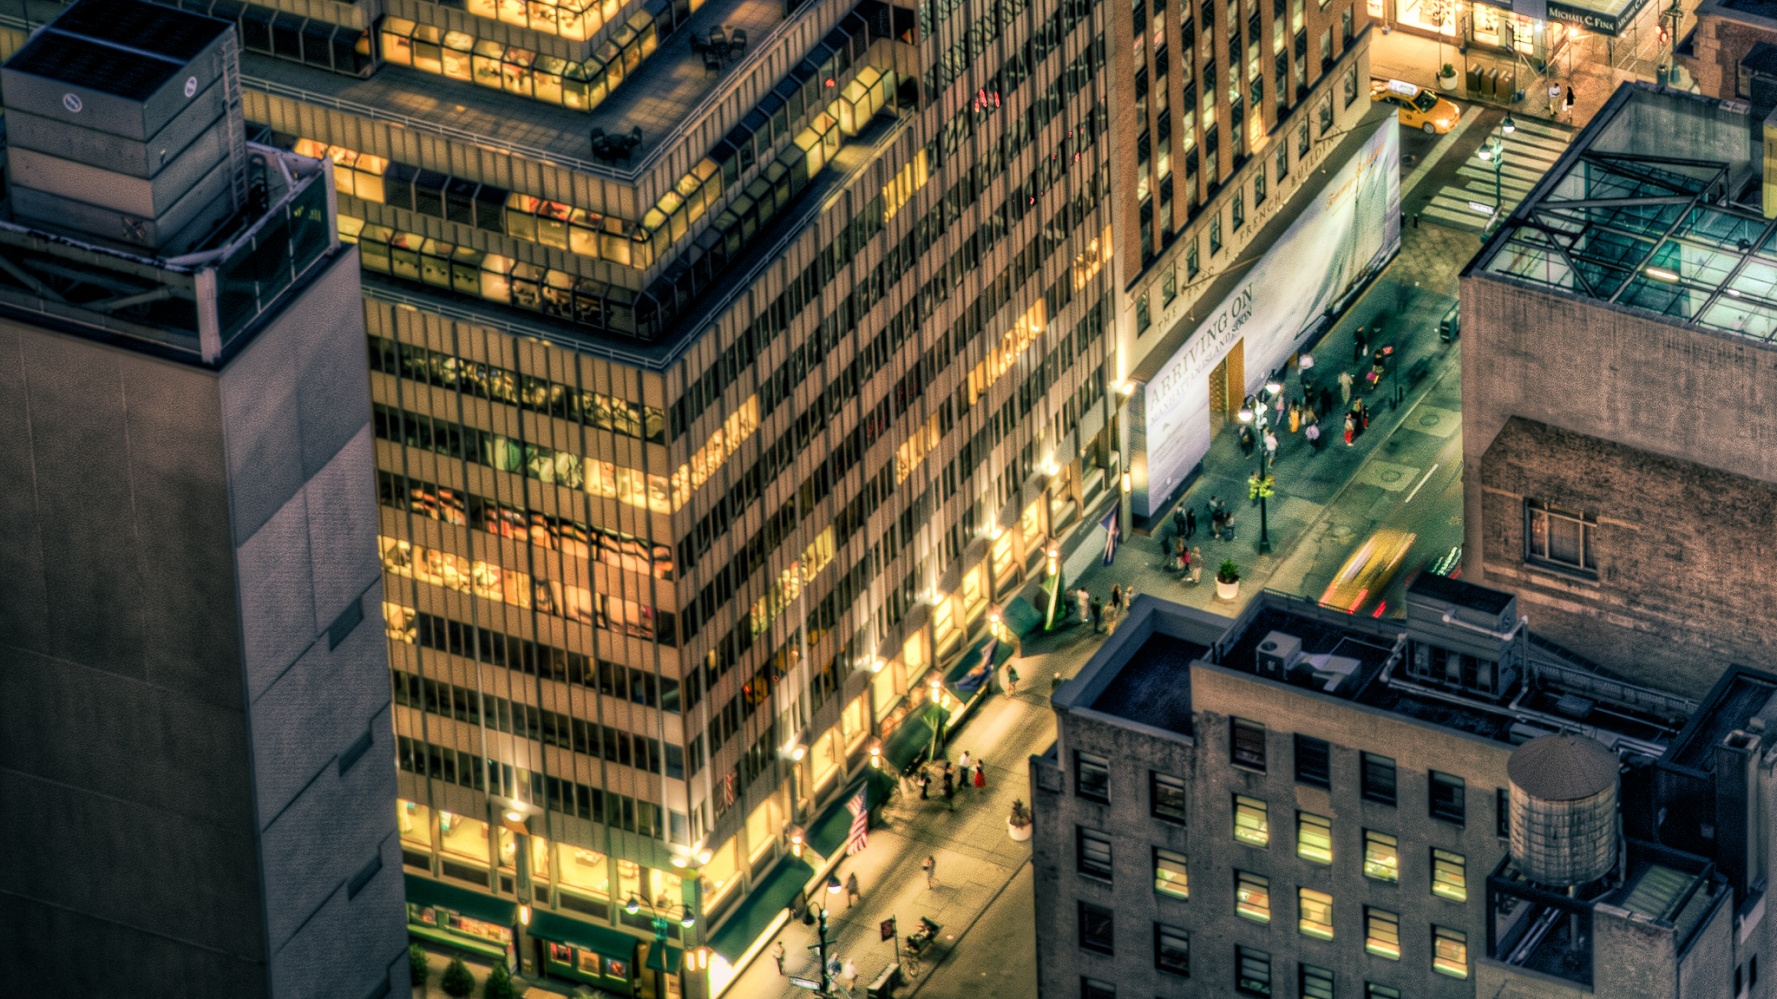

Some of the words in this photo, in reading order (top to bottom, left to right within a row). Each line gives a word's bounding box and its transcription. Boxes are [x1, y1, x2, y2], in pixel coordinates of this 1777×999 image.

[1549, 6, 1583, 23] MICHAEL
[1594, 17, 1615, 32] FINA
[1239, 191, 1282, 242] FRENCH
[1150, 309, 1228, 412] ARRIVING
[1231, 282, 1253, 318] ON
